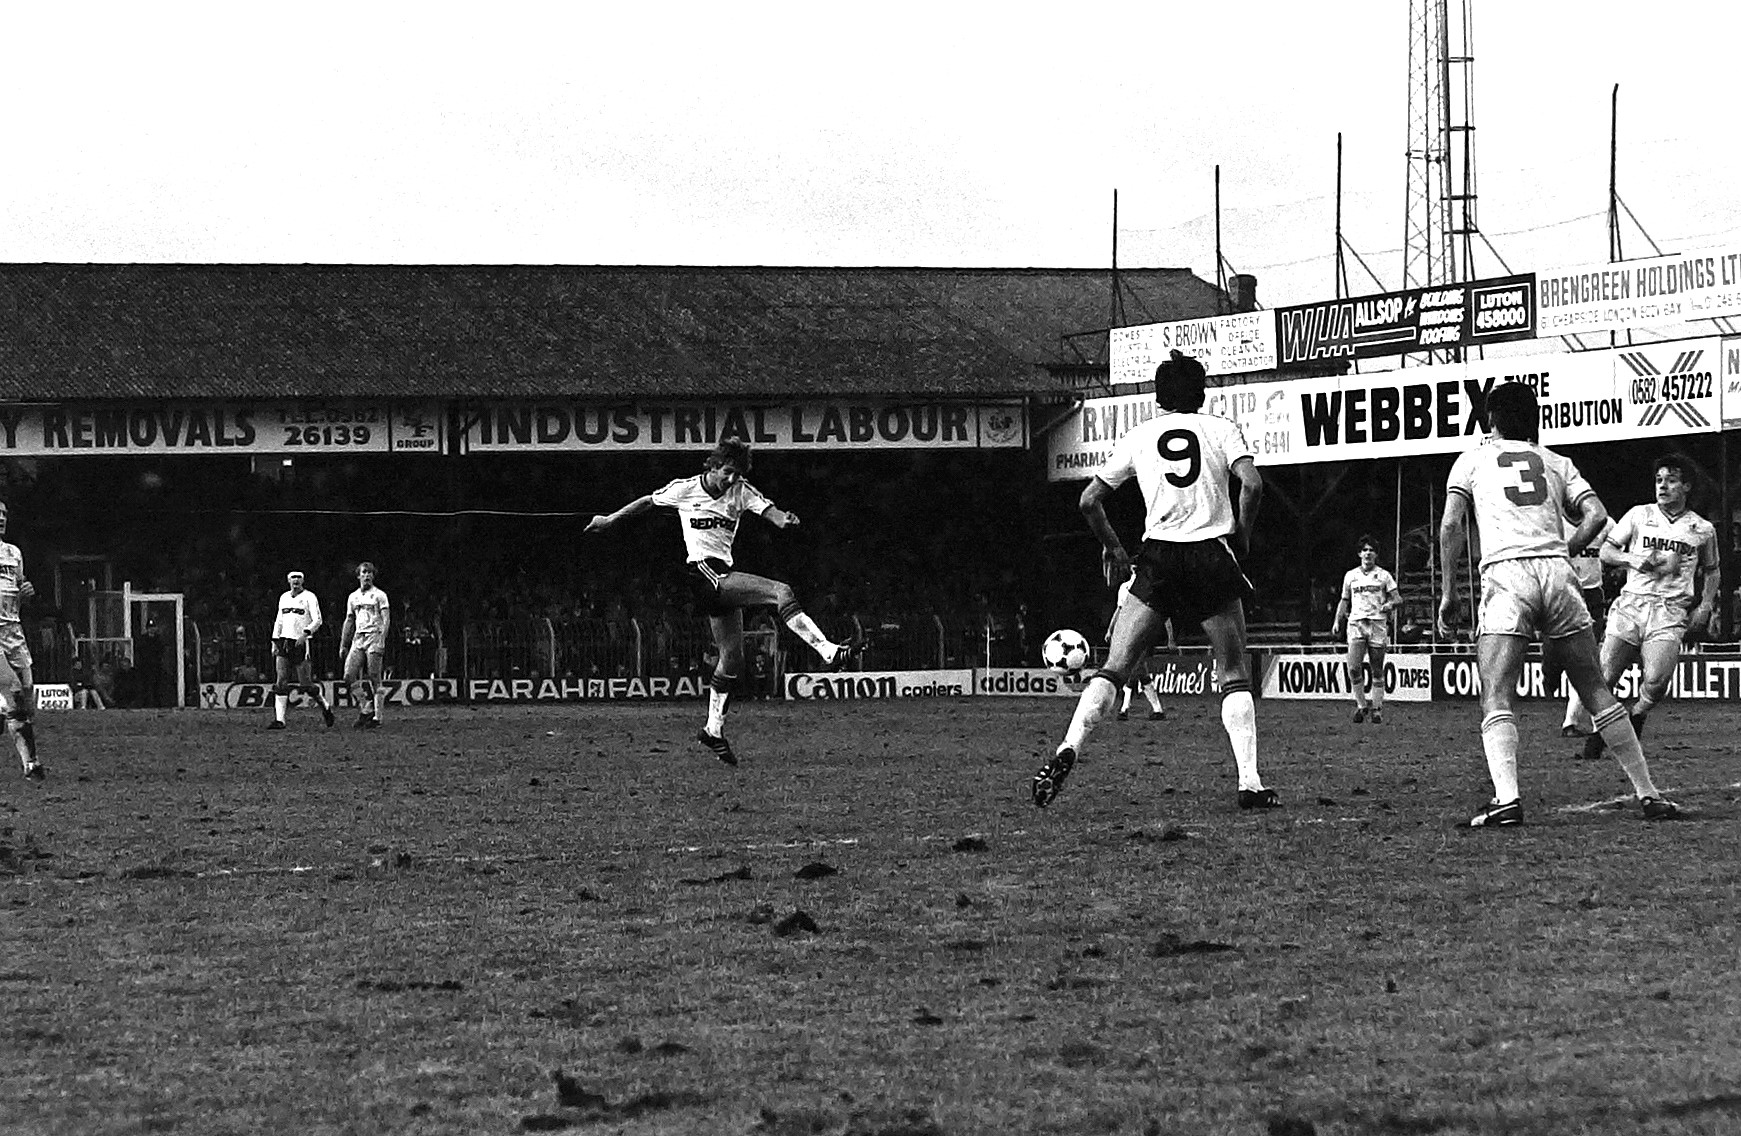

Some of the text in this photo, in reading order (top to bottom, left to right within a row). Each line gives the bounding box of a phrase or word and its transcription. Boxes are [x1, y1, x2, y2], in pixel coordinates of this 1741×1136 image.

[1540, 253, 1741, 308] BRENGREEN HOLDINGS LT
[1355, 296, 1403, 328] ALLSOP
[1480, 290, 1524, 309] LUTON
[1220, 315, 1260, 329] FACTORY
[1476, 307, 1527, 329] 458000
[1176, 320, 1217, 346] BROWN
[1221, 355, 1274, 369] CONTRACTOR
[1661, 371, 1713, 402] 457222
[480, 404, 777, 444] INDUSTRIAL
[791, 404, 968, 443] LABOUR
[1300, 376, 1496, 447] WEBBEX
[43, 405, 256, 448] REMOVALS
[283, 425, 371, 446] 26139
[396, 439, 435, 449] GROUP
[1157, 428, 1201, 488] 9
[1497, 450, 1548, 506] 3
[469, 679, 584, 700] FARAH
[788, 673, 963, 700] Canon copiers
[979, 671, 1058, 695] adidas
[1278, 661, 1340, 694] KODAK
[1397, 668, 1430, 689] TAPES
[41, 687, 69, 697] LUTON
